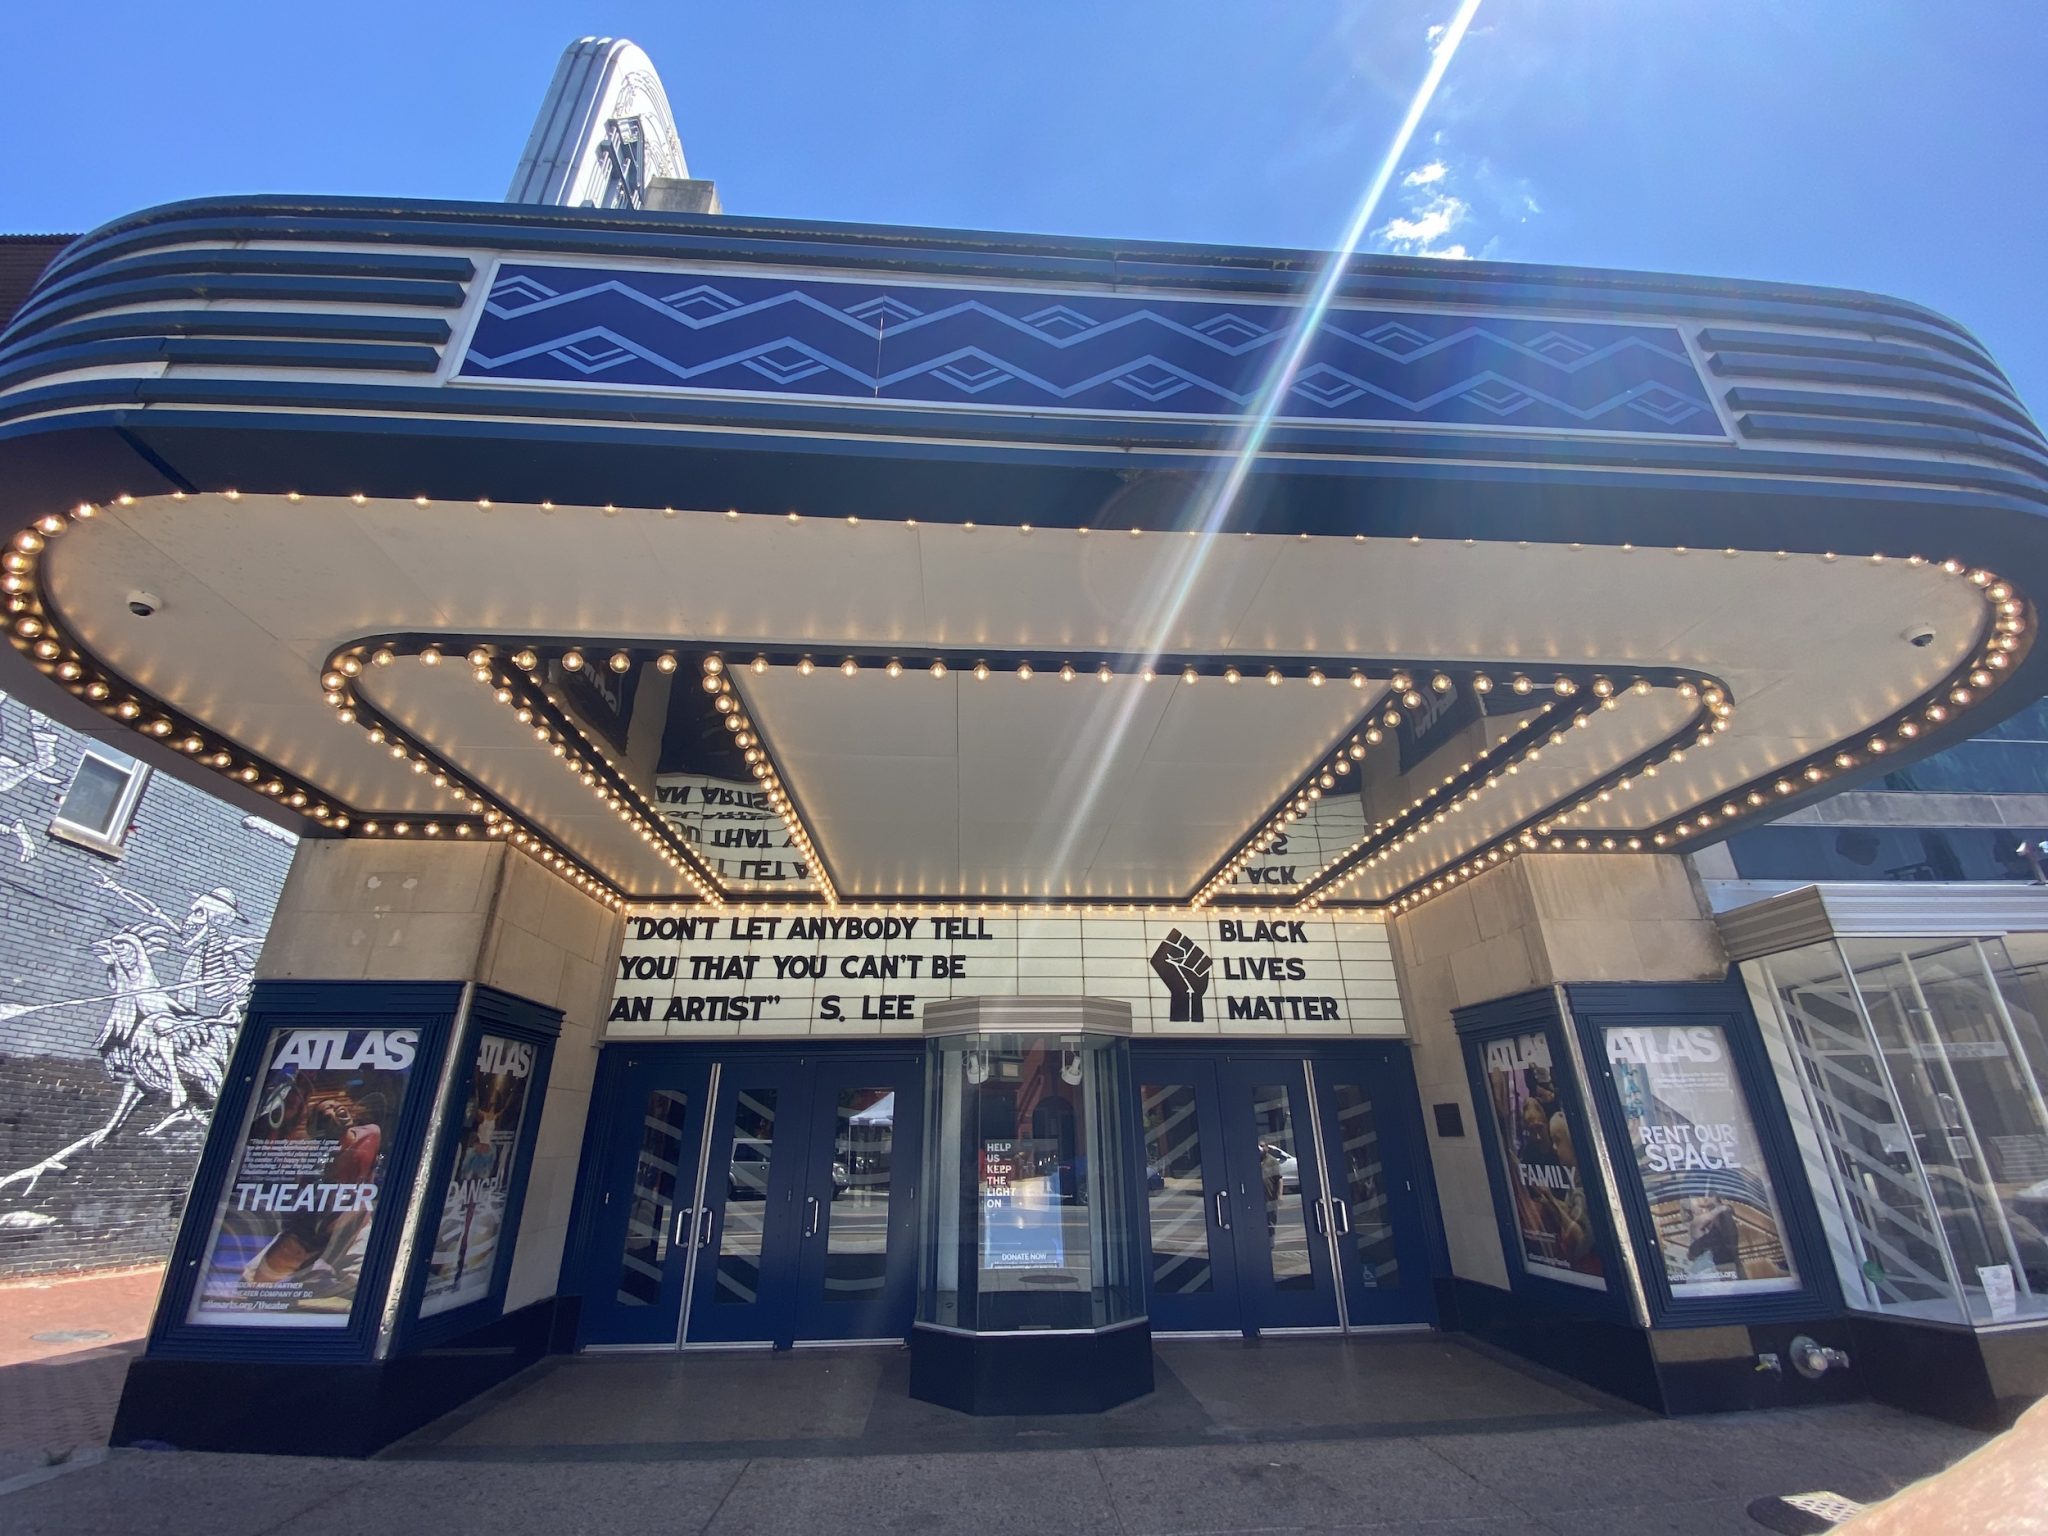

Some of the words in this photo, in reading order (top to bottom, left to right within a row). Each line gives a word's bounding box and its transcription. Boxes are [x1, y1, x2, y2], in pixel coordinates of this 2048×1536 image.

[626, 916, 720, 940] "DON'T
[730, 916, 782, 940] LET
[787, 916, 920, 940] ANYBODY
[930, 916, 993, 940] TELL
[1218, 919, 1309, 943] BLACK
[619, 955, 678, 980] YOU
[690, 955, 760, 980] THAT
[773, 955, 828, 980] YOU
[840, 954, 924, 979] CAN'T
[932, 954, 967, 979] BE
[1223, 957, 1306, 981] LIVES
[608, 996, 653, 1022] AN
[663, 995, 781, 1021] ARTIST"
[820, 995, 846, 1022] S.
[861, 994, 916, 1020] LEE
[1226, 995, 1341, 1022] MATTER
[271, 1029, 419, 1071] ATLAS
[476, 1034, 533, 1078] ATLAS
[1605, 1026, 1722, 1065] ATLAS
[1639, 1124, 1690, 1146] RENT
[1693, 1123, 1736, 1145] OUR
[986, 1143, 1012, 1152] HELP
[986, 1154, 1000, 1163] US
[1644, 1142, 1741, 1173] SPACE
[986, 1164, 1012, 1174] KEEP
[986, 1176, 1007, 1185] THE
[1518, 1163, 1577, 1191] FAMILY
[234, 1182, 379, 1213] THEATER
[986, 1187, 1017, 1197] LIGHT
[986, 1198, 1002, 1209] ON
[1001, 1252, 1030, 1261] DONATE
[1030, 1252, 1047, 1261] NOW
